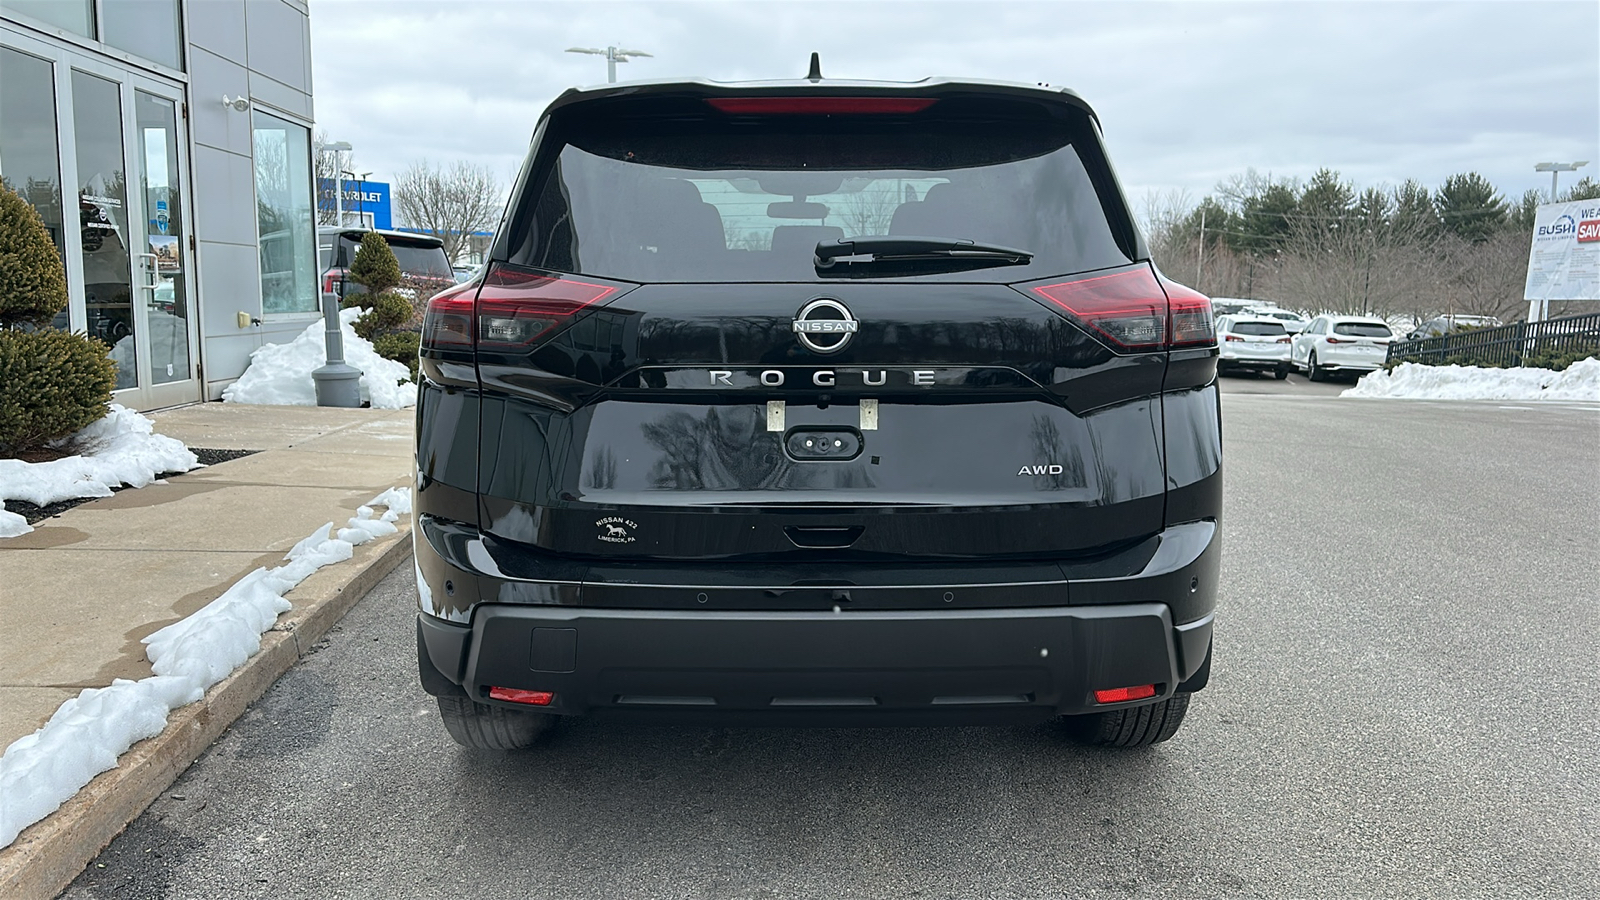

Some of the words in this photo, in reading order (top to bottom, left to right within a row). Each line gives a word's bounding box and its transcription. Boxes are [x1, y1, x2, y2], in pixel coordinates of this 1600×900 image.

[1581, 209, 1594, 218] WE
[1538, 224, 1572, 235] BUSH
[794, 322, 857, 332] NISSAN
[709, 370, 936, 386] ROGUE
[1017, 464, 1063, 476] AWD
[595, 516, 623, 526] NISSAN
[625, 519, 638, 529] 422
[597, 534, 627, 543] LIMERICK,
